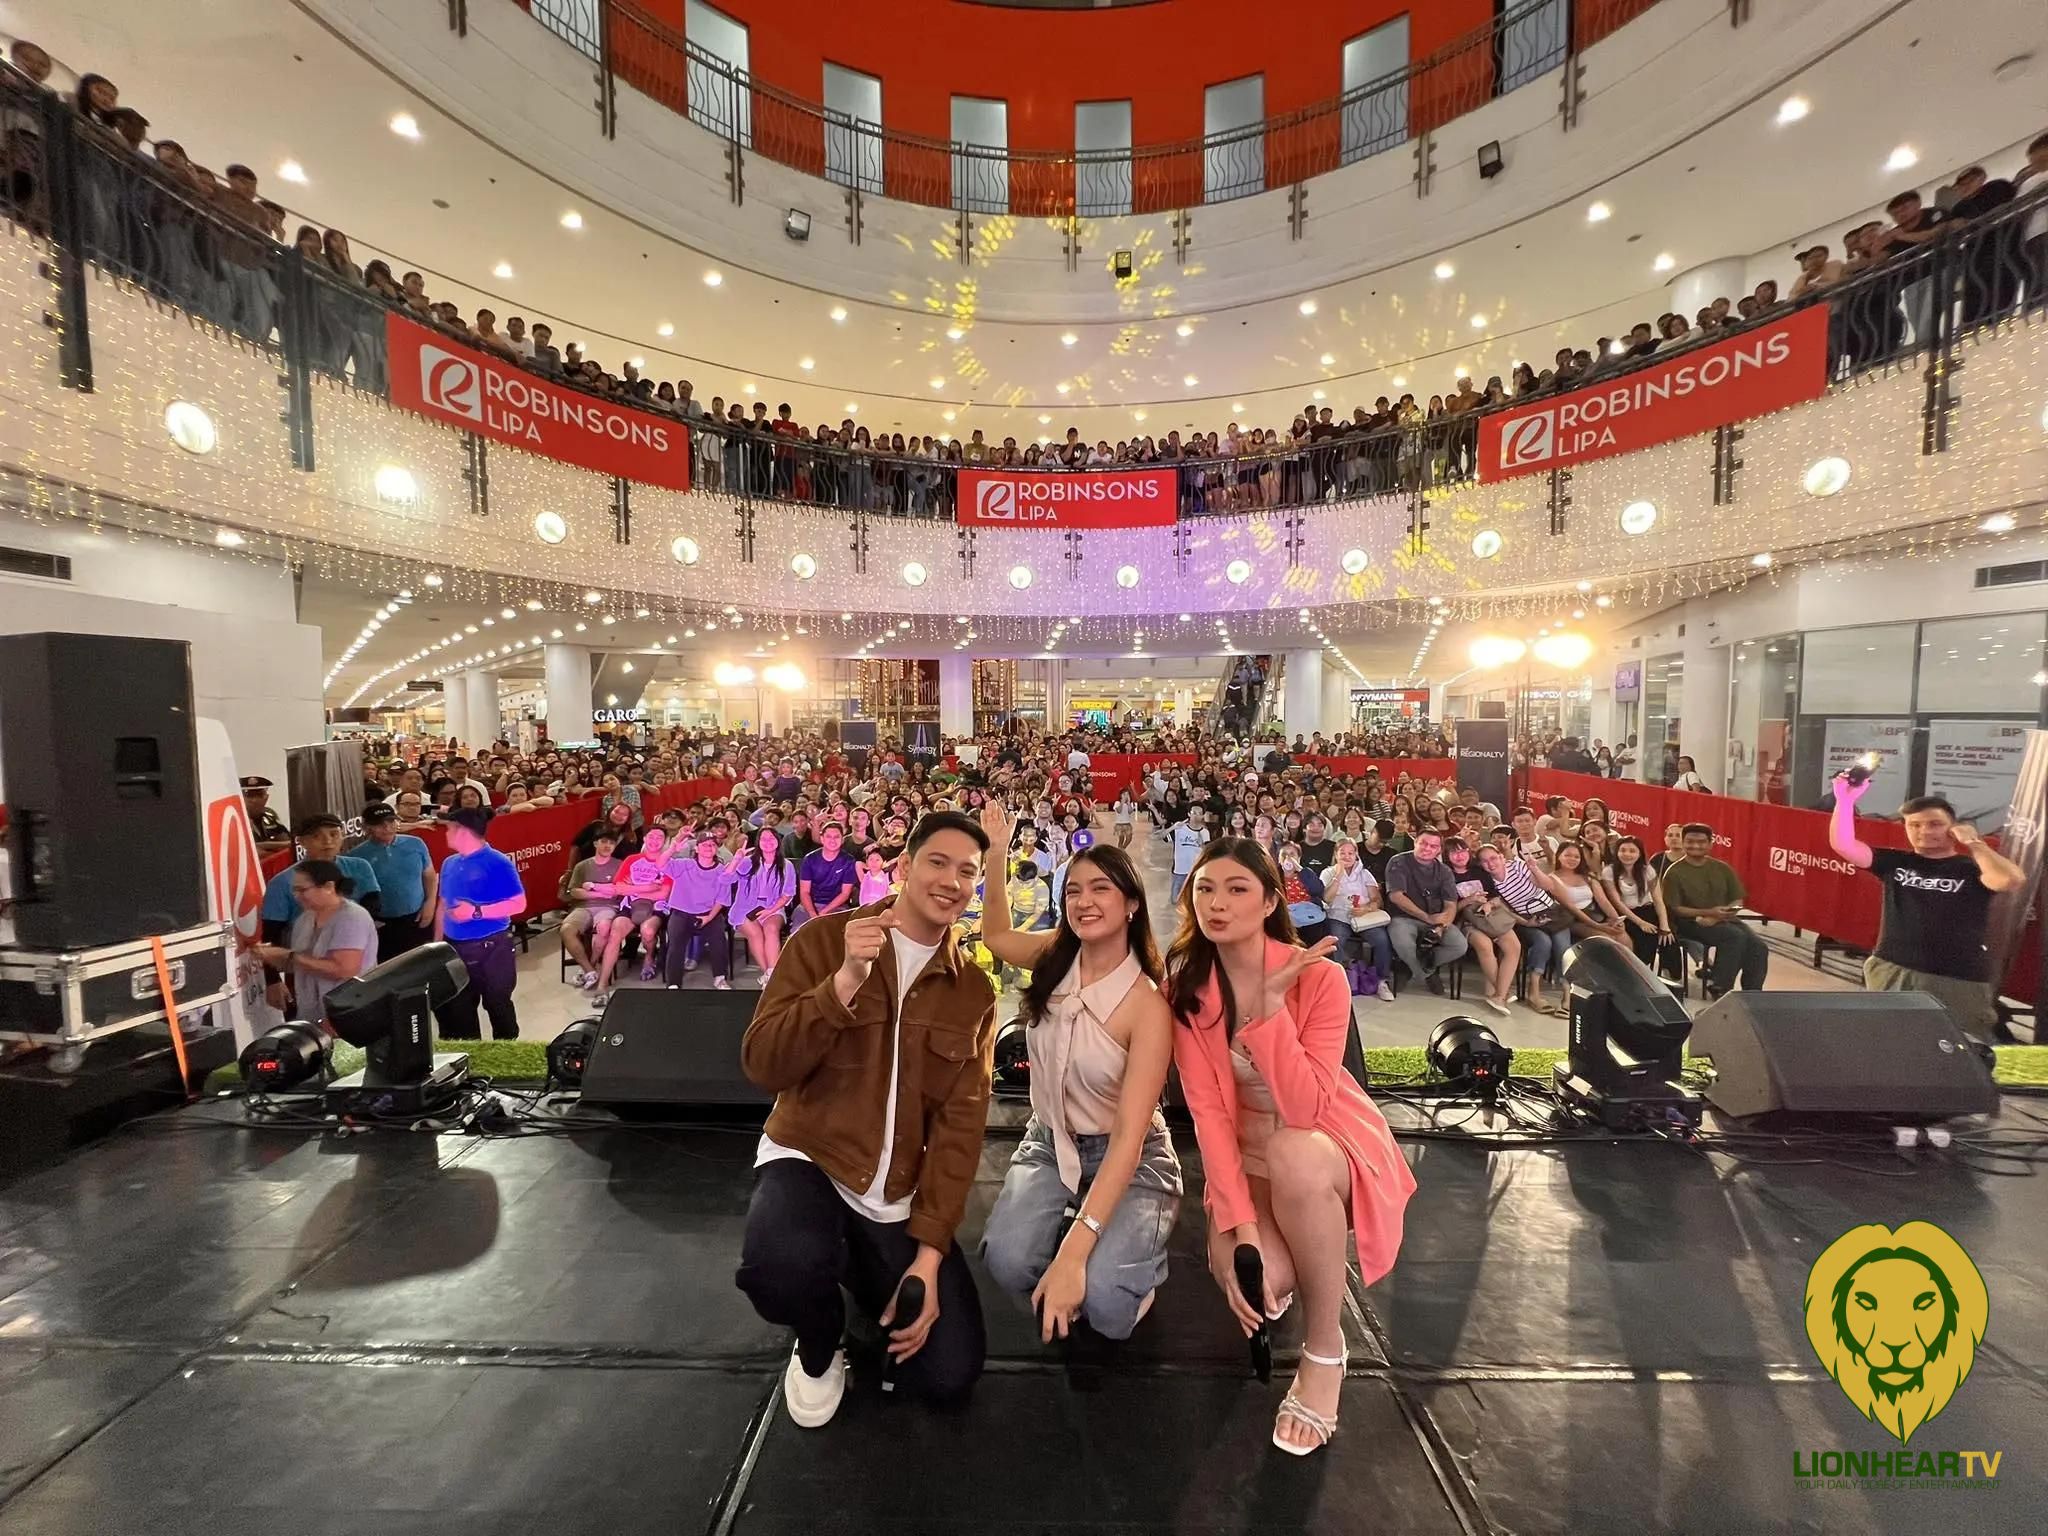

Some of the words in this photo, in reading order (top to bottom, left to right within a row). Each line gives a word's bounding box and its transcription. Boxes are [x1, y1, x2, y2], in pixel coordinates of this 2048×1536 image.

[1559, 332, 1791, 430] ROBINSONS
[485, 368, 669, 452] ROBINSONS
[487, 405, 543, 444] LIPA
[1559, 426, 1617, 457] LIPA
[1018, 480, 1159, 501] ROBINSONS
[1019, 506, 1058, 521] LIPA
[592, 709, 637, 722] GARO
[1788, 850, 1856, 876] ROBINSONS
[1894, 867, 1965, 893] Synergy
